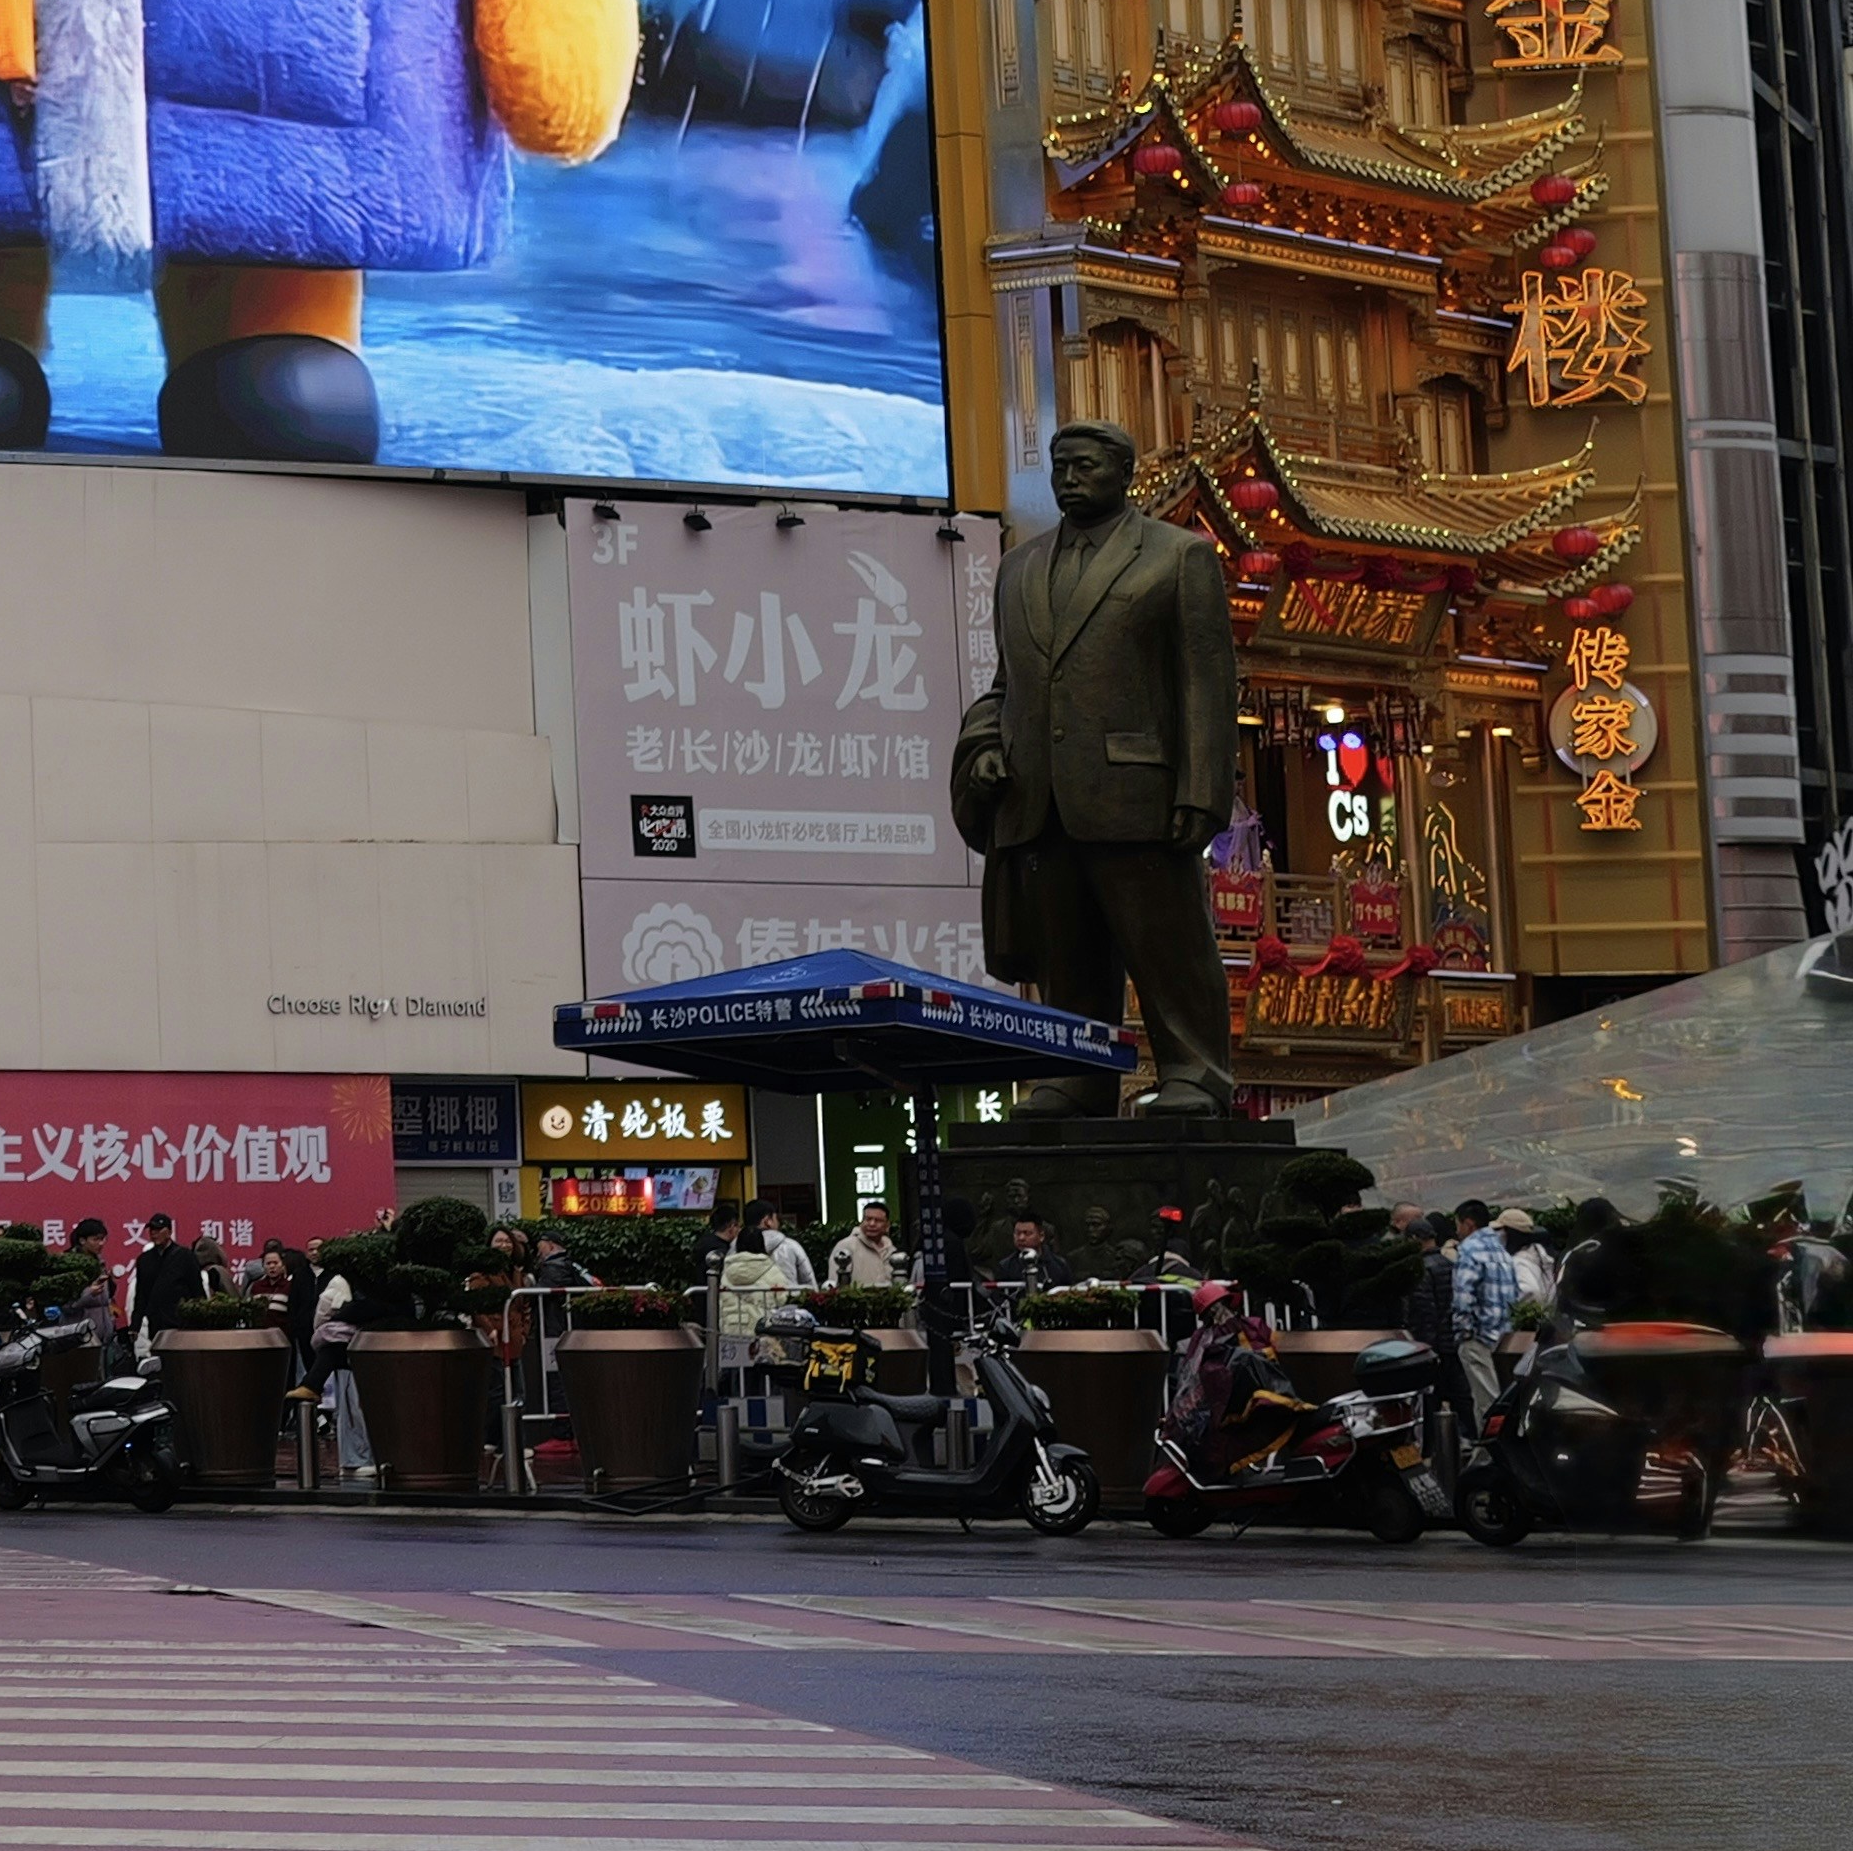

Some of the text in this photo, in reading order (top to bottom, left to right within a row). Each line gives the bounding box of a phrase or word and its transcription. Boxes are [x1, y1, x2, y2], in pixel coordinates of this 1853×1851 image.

[592, 524, 638, 564] 3F
[619, 584, 930, 711] 虾小龙
[1567, 627, 1645, 834] 传家金
[652, 838, 678, 852] 2020
[708, 819, 927, 846] 全国小龙虾必吃餐厅上榜品牌
[267, 994, 341, 1016] Choose
[406, 996, 487, 1017] Diamond
[650, 998, 792, 1031] 长沙POLICE特警
[969, 1005, 1068, 1049] 长沙POLICE特警
[201, 1219, 255, 1247] 和谐
